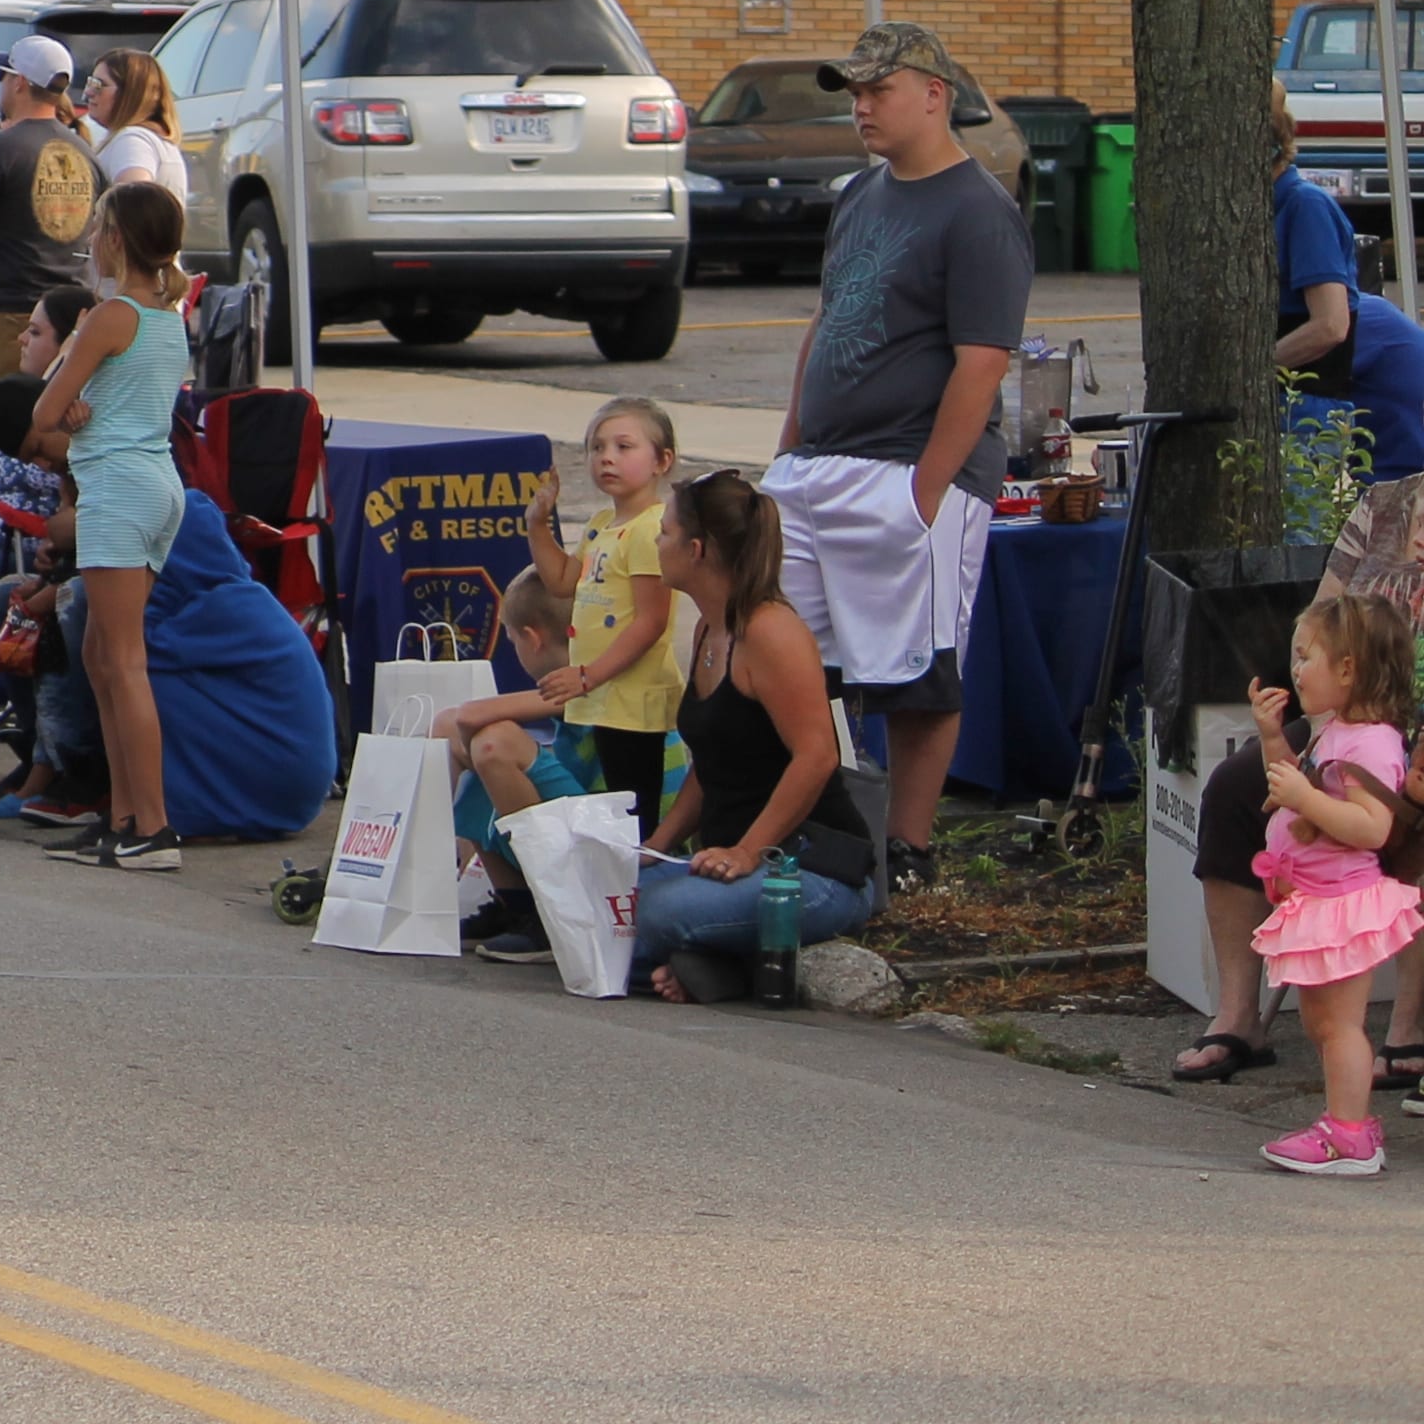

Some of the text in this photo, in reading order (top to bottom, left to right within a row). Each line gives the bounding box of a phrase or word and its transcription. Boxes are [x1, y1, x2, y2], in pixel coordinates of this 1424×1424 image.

[503, 93, 545, 105] GMC
[410, 520, 429, 541] &
[414, 579, 481, 599] CITY OF
